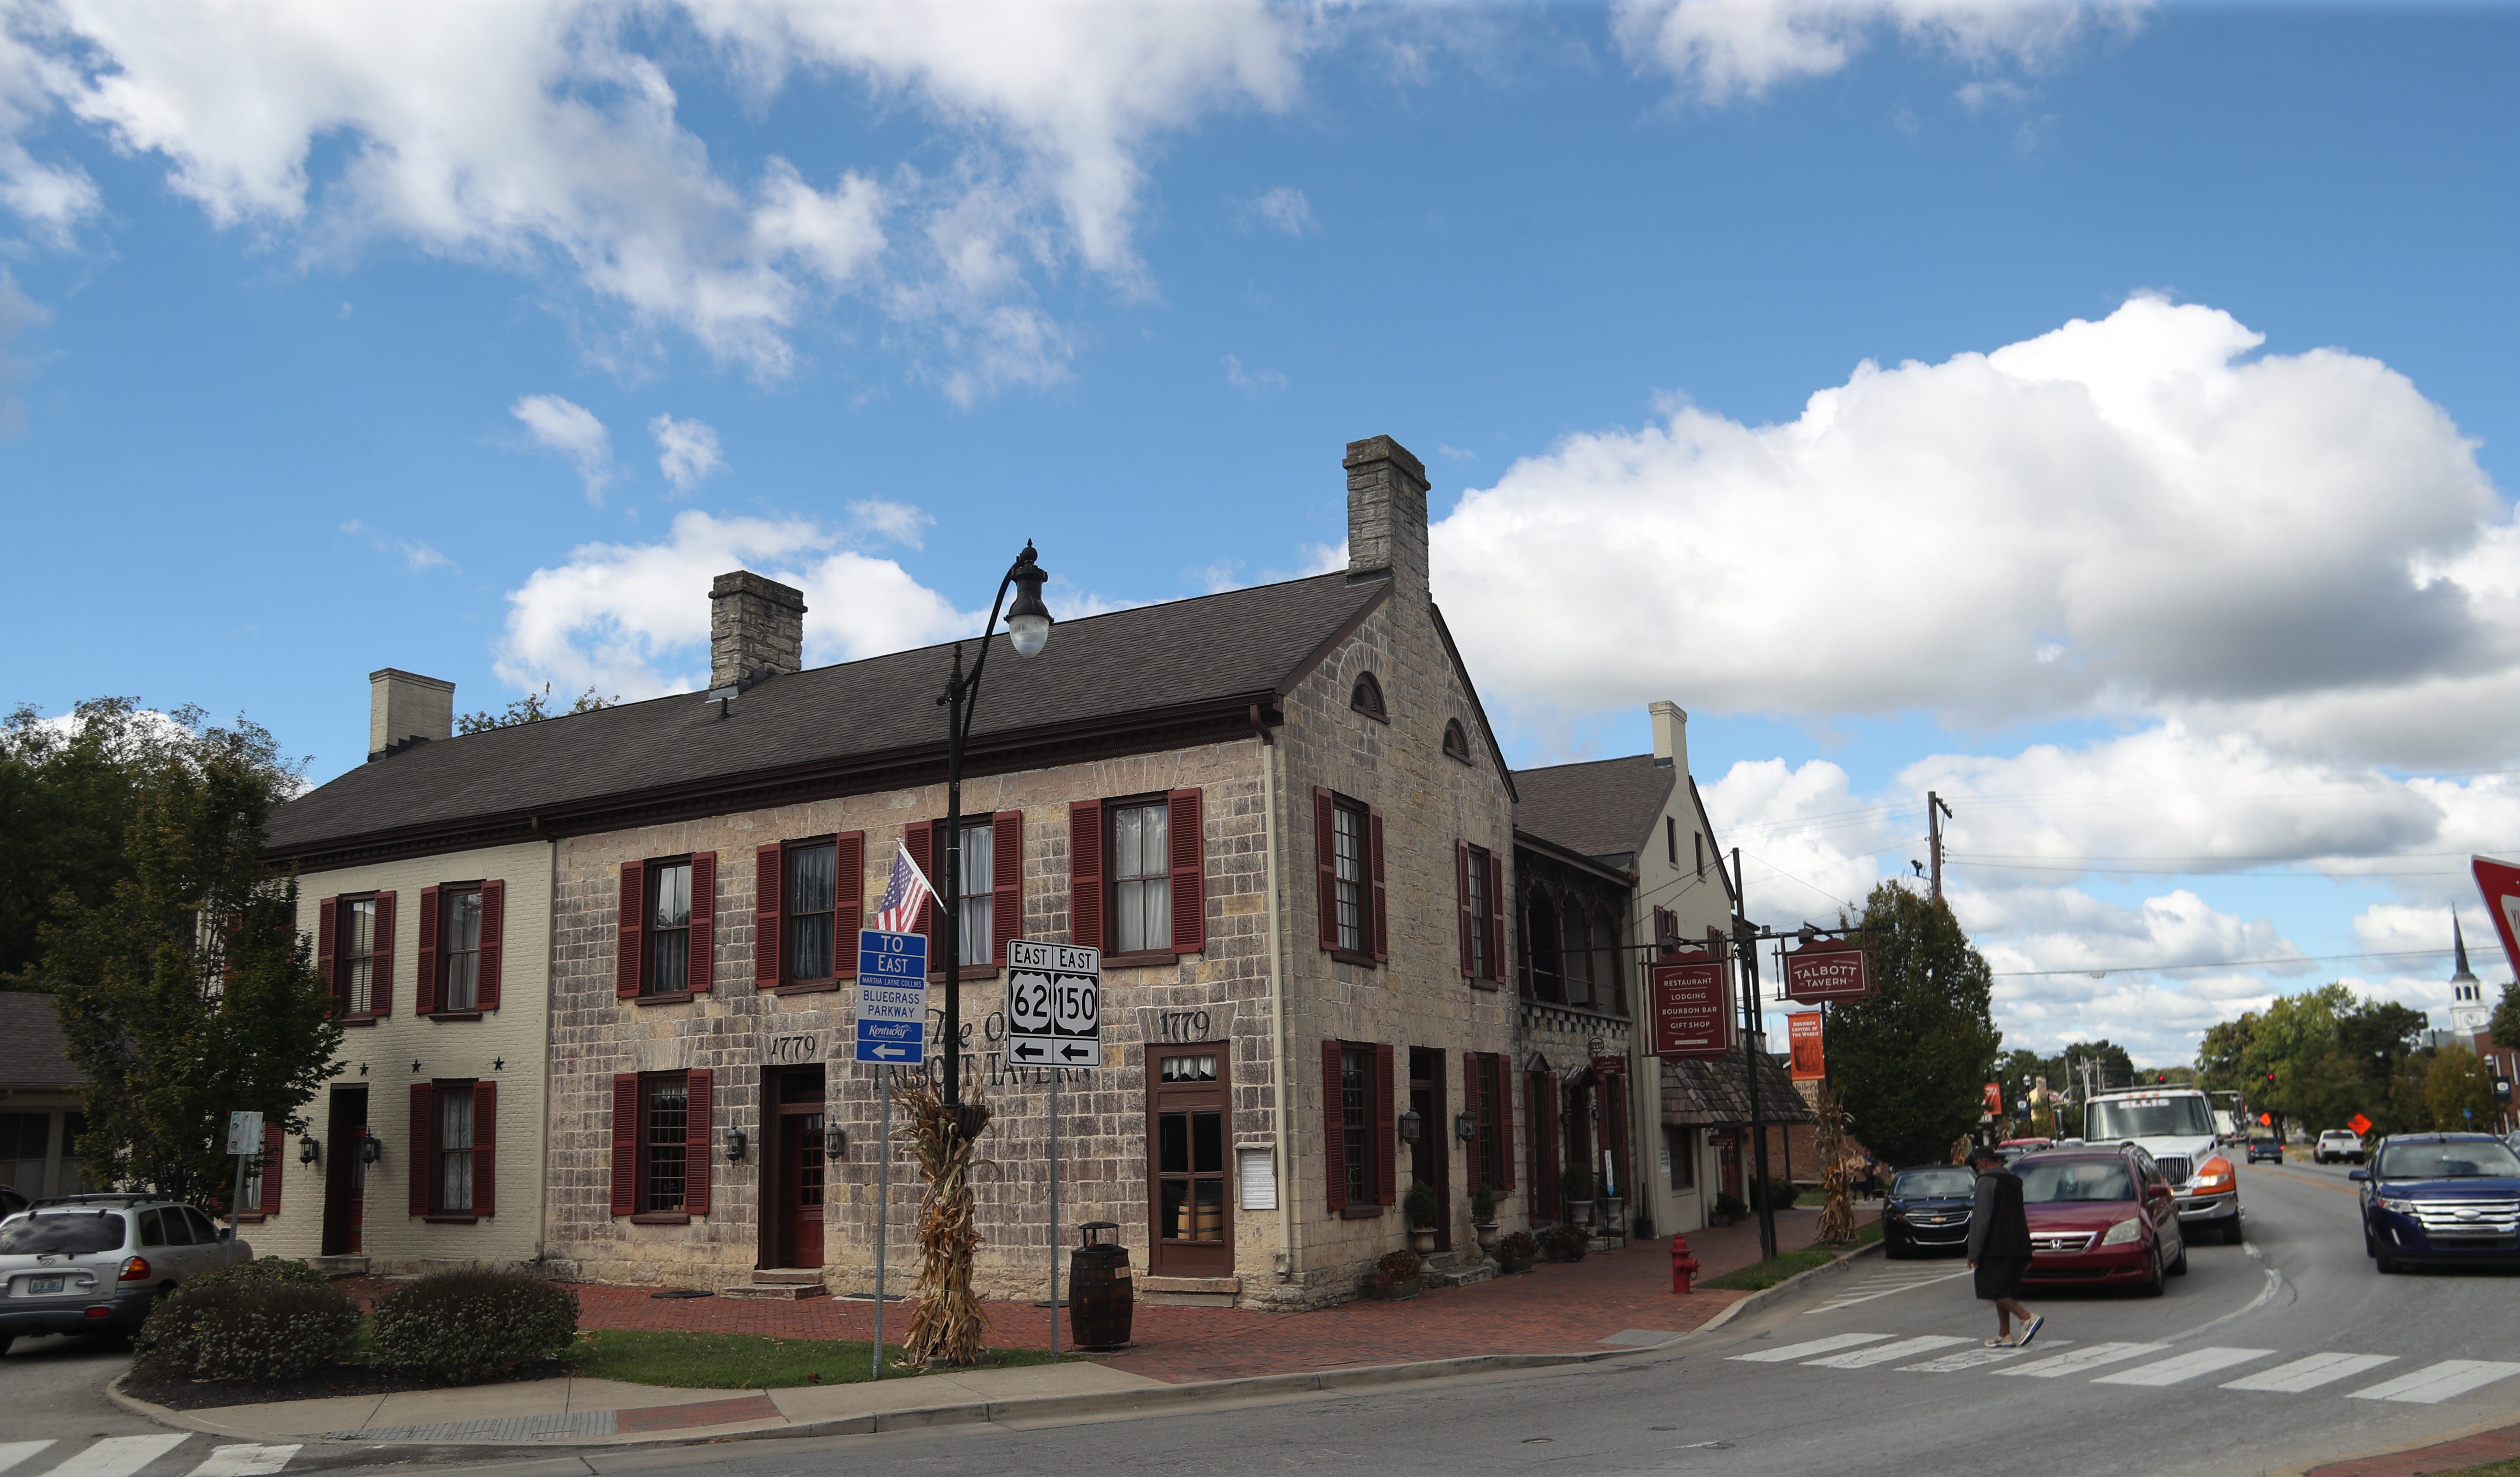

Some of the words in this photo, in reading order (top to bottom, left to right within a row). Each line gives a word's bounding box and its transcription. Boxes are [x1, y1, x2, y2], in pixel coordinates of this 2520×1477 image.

[881, 935, 904, 953] TO
[1015, 944, 1047, 965] EAST
[1060, 948, 1091, 969] EAST
[878, 954, 908, 973] EAST
[1794, 965, 1857, 980] TALBOTT
[862, 976, 882, 985] MARTHA
[1664, 977, 1712, 987] RESTAURANT
[1805, 977, 1847, 987] TAVERN
[863, 990, 920, 1004] BLUEGRASS
[1015, 983, 1047, 1017] 62
[1058, 987, 1095, 1021] 150
[1671, 992, 1706, 1001] LODGING
[868, 1004, 915, 1018] PARKWAY
[868, 1024, 906, 1039] Kentucky
[1160, 1010, 1210, 1041] 1779
[770, 1035, 816, 1062] 1779
[2118, 1098, 2170, 1109] ELLIS
